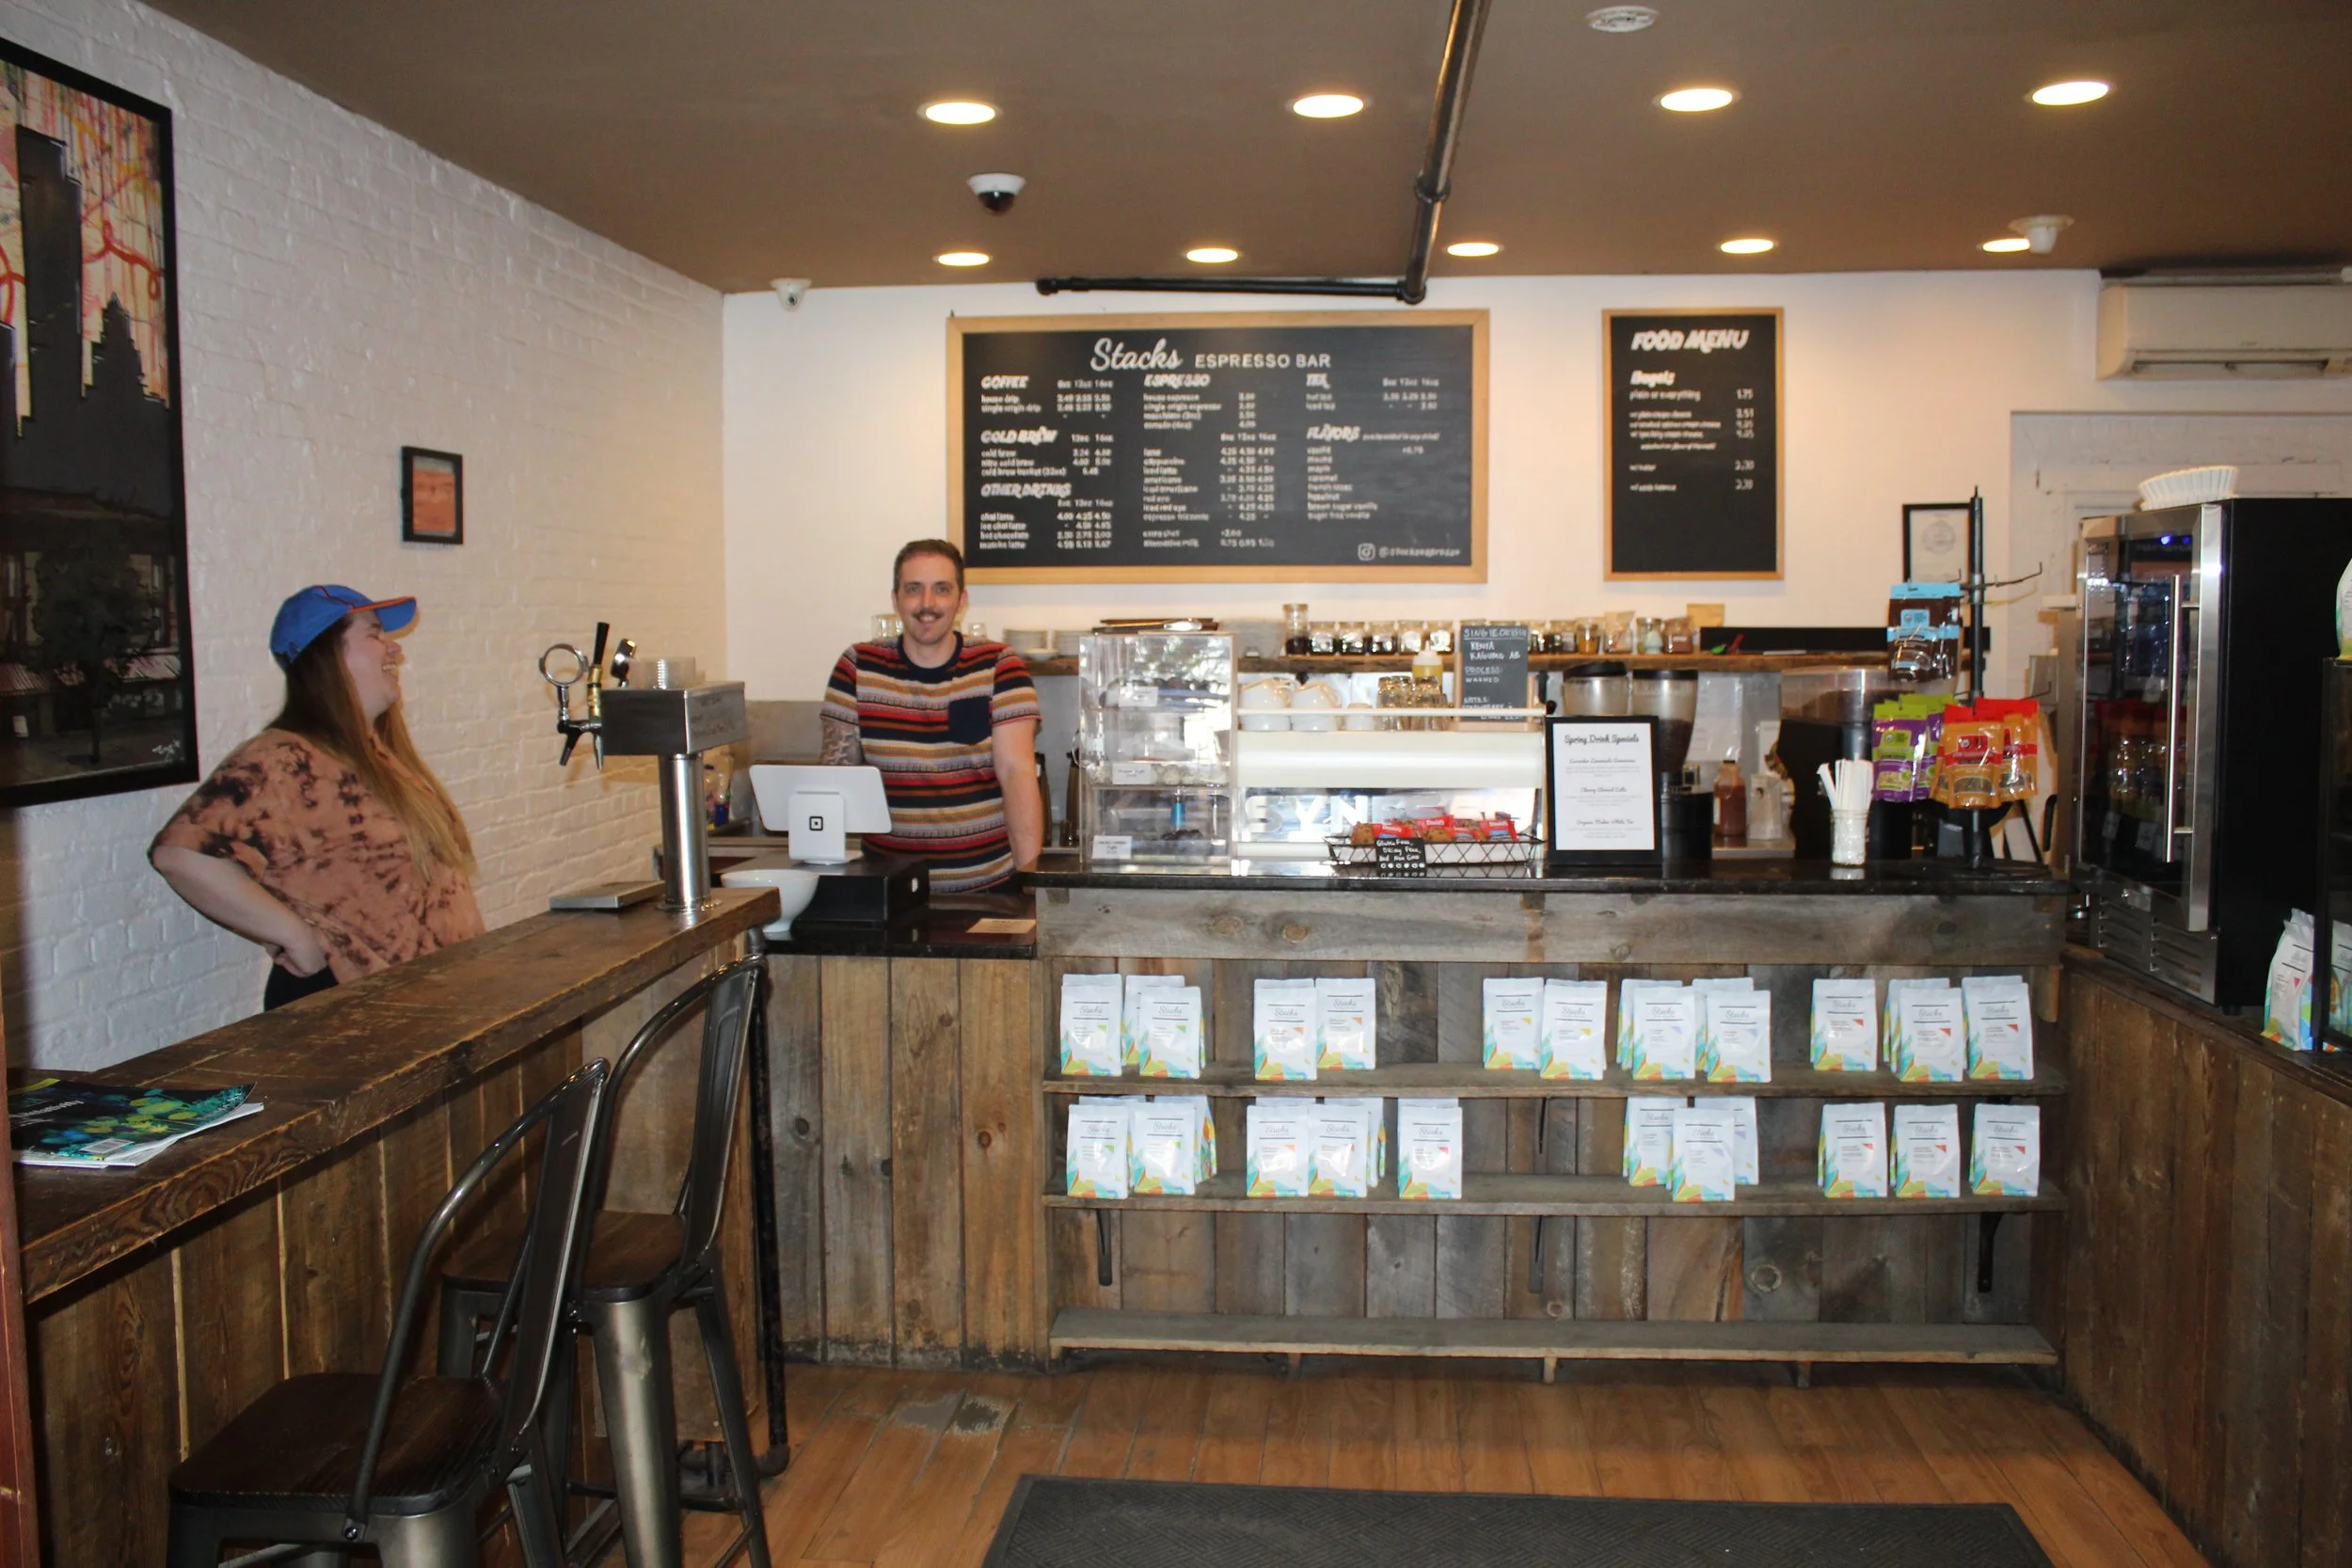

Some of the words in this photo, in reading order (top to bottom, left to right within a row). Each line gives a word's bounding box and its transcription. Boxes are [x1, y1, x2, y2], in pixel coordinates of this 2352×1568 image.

[1631, 330, 1684, 351] FOOD
[1685, 329, 1749, 354] MENU
[1090, 338, 1184, 372] Stacks
[1195, 354, 1290, 369] ESPRESSO
[1295, 354, 1331, 368] BAR
[1144, 373, 1211, 389] ESPRESSO
[1004, 395, 1019, 404] drip
[980, 430, 1017, 443] COLD
[1017, 425, 1057, 446] BREW
[980, 483, 1022, 498] OTHER
[1022, 483, 1072, 499] DRINKS
[1565, 735, 1587, 745] Spring
[1589, 734, 1610, 743] Drink
[1612, 734, 1639, 745] Specials
